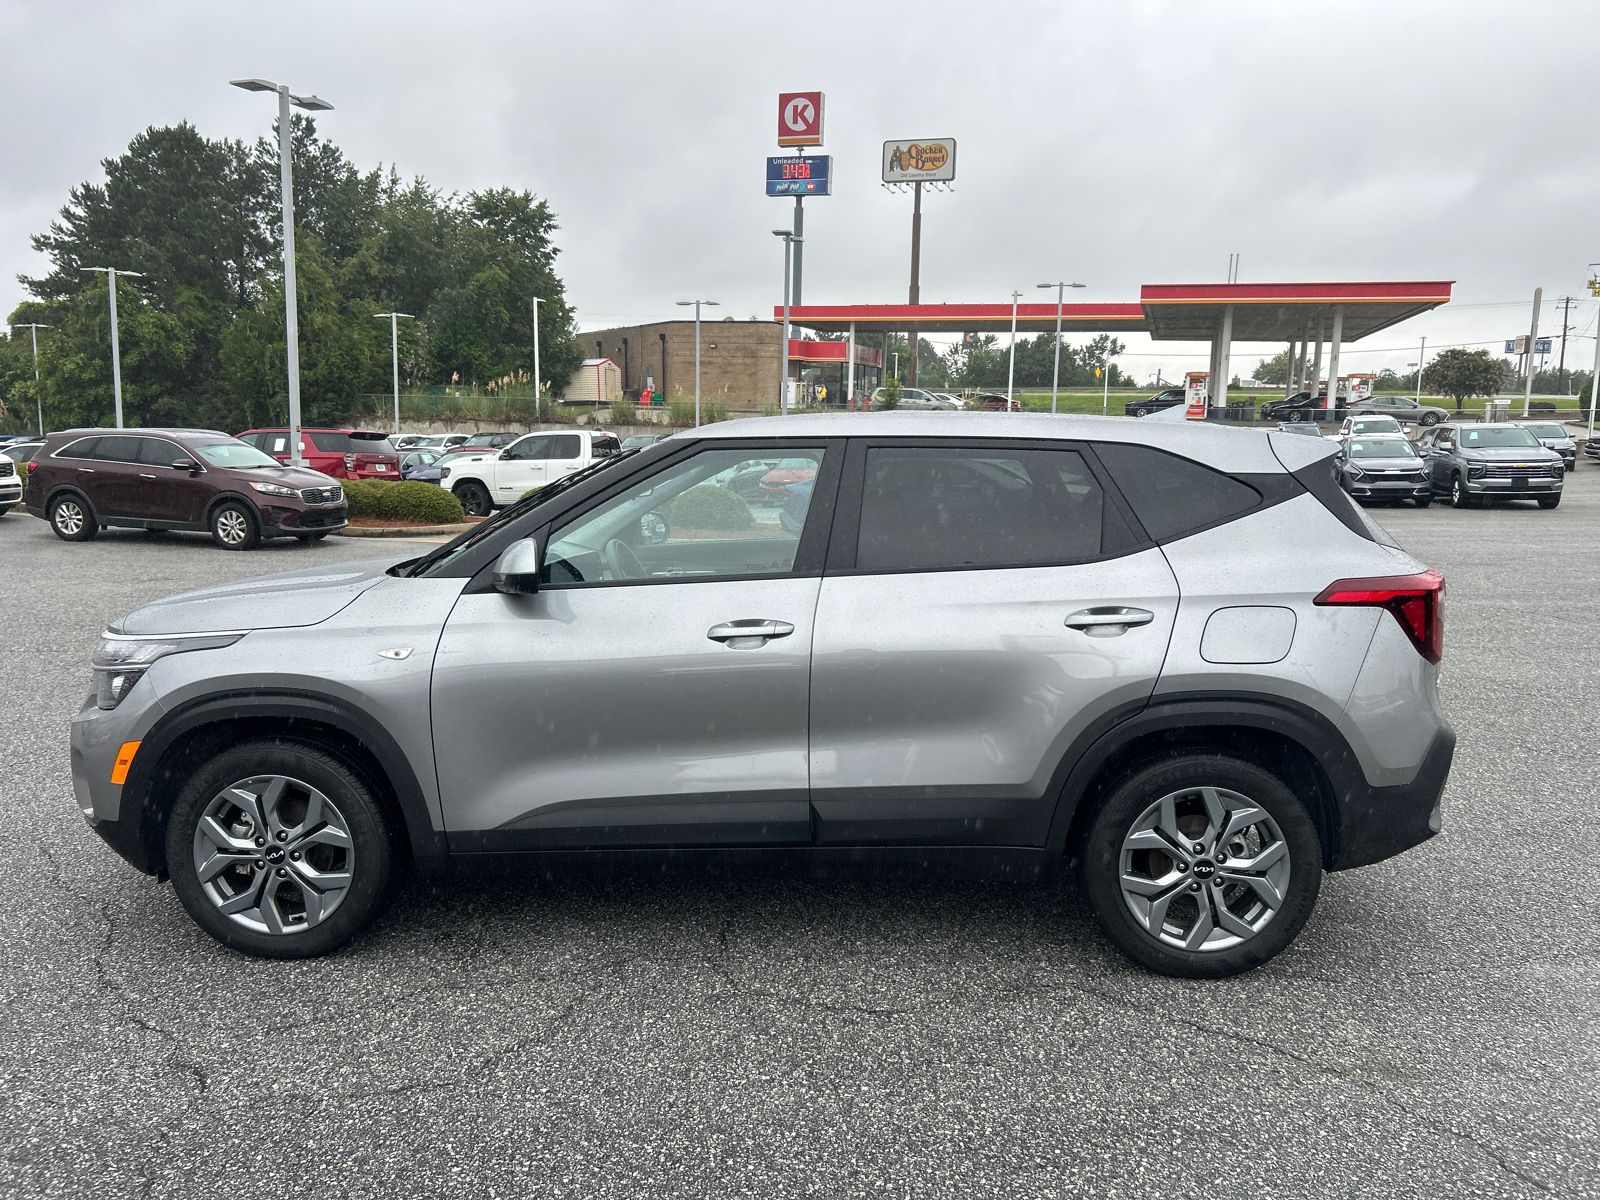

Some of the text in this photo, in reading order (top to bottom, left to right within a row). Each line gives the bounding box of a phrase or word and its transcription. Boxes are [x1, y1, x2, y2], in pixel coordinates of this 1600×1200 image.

[791, 103, 813, 129] K
[909, 145, 943, 159] Cracker
[916, 154, 944, 169] Barrel
